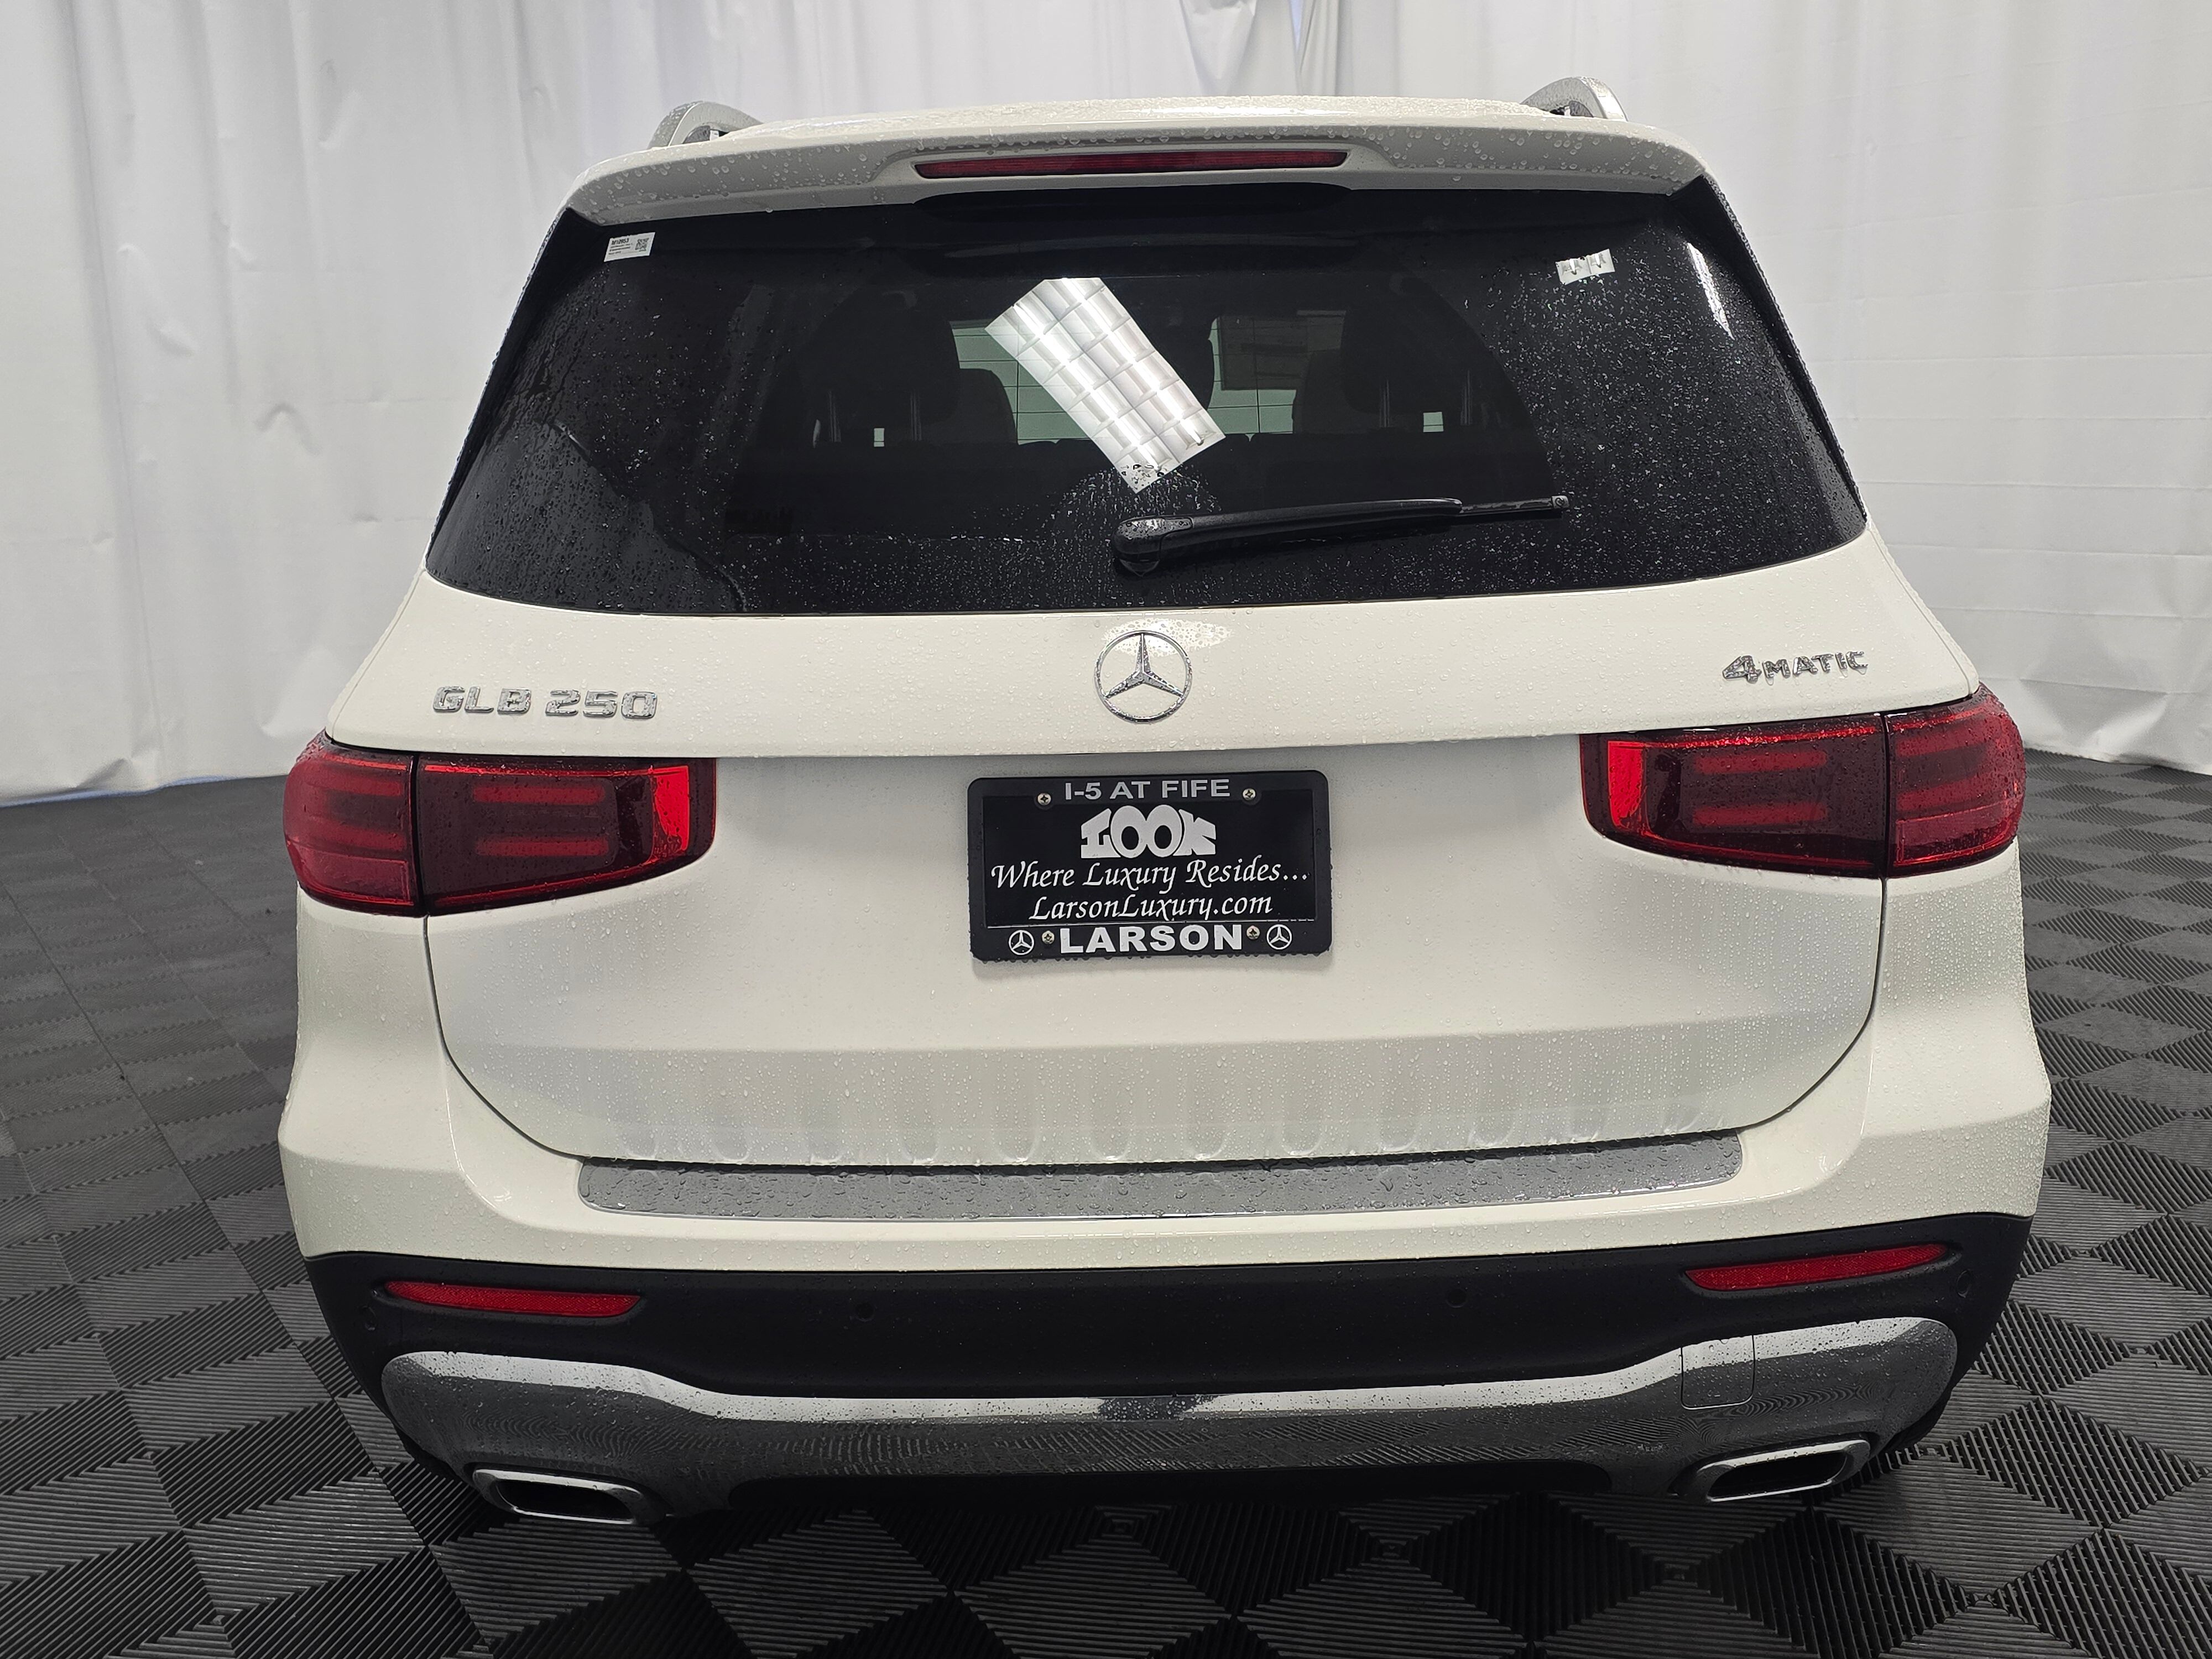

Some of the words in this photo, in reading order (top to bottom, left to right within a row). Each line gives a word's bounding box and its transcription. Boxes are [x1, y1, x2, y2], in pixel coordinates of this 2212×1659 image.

[1722, 651, 1869, 684] 4MATIC
[432, 686, 531, 714] GLB
[545, 689, 658, 719] 250
[1065, 782, 1102, 800] I-5
[1109, 781, 1151, 799] AT
[1162, 779, 1230, 798] FIFE
[1081, 804, 1217, 859] LOOK
[991, 860, 1074, 888] Where
[1082, 862, 1177, 894] Luxury
[1185, 854, 1308, 888] Resides...
[1028, 891, 1274, 921] LarsonLuxury.com
[1060, 924, 1243, 954] LARSON
